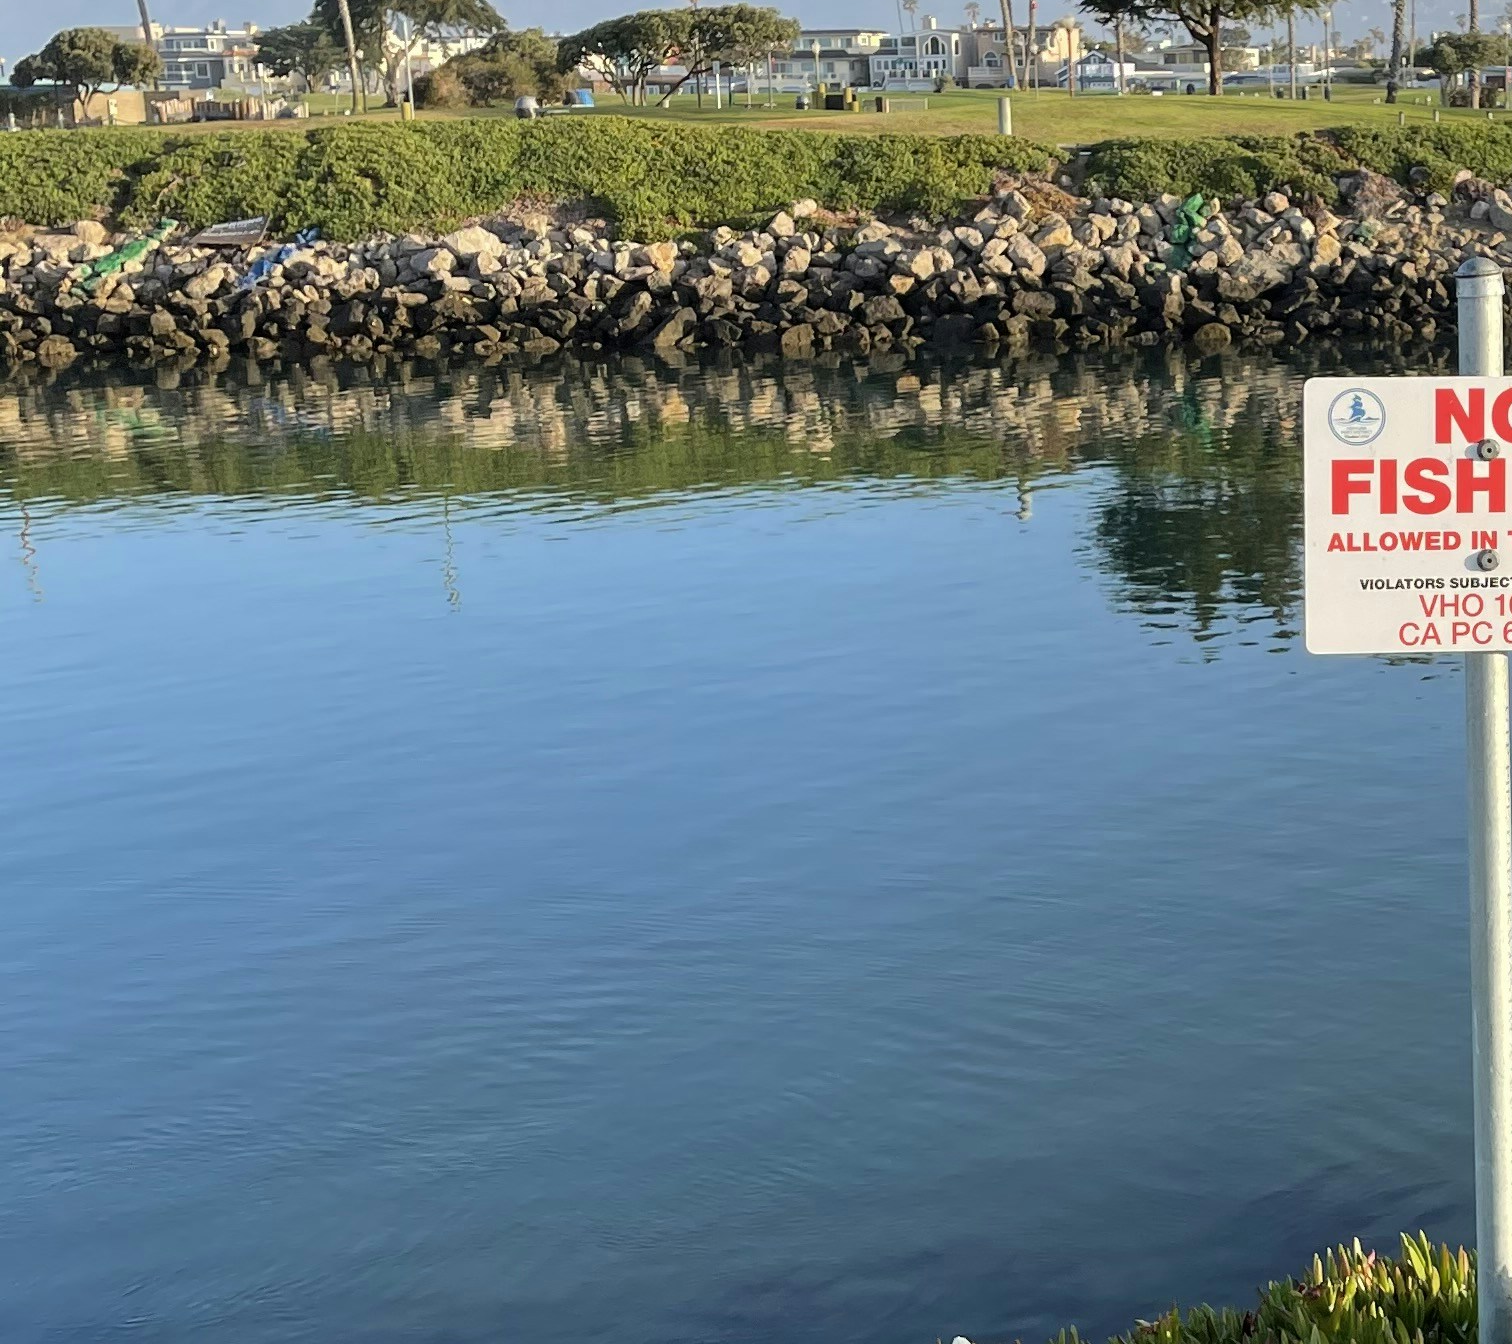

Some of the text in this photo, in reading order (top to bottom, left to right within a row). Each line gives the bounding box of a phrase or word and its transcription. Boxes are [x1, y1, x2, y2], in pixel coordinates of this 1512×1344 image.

[1327, 531, 1461, 552] ALLOWED
[1471, 531, 1498, 550] IN
[1360, 578, 1445, 590] VIOLATORS
[1419, 594, 1484, 617] VHO
[1398, 622, 1442, 646] CA
[1452, 621, 1493, 645] PC
